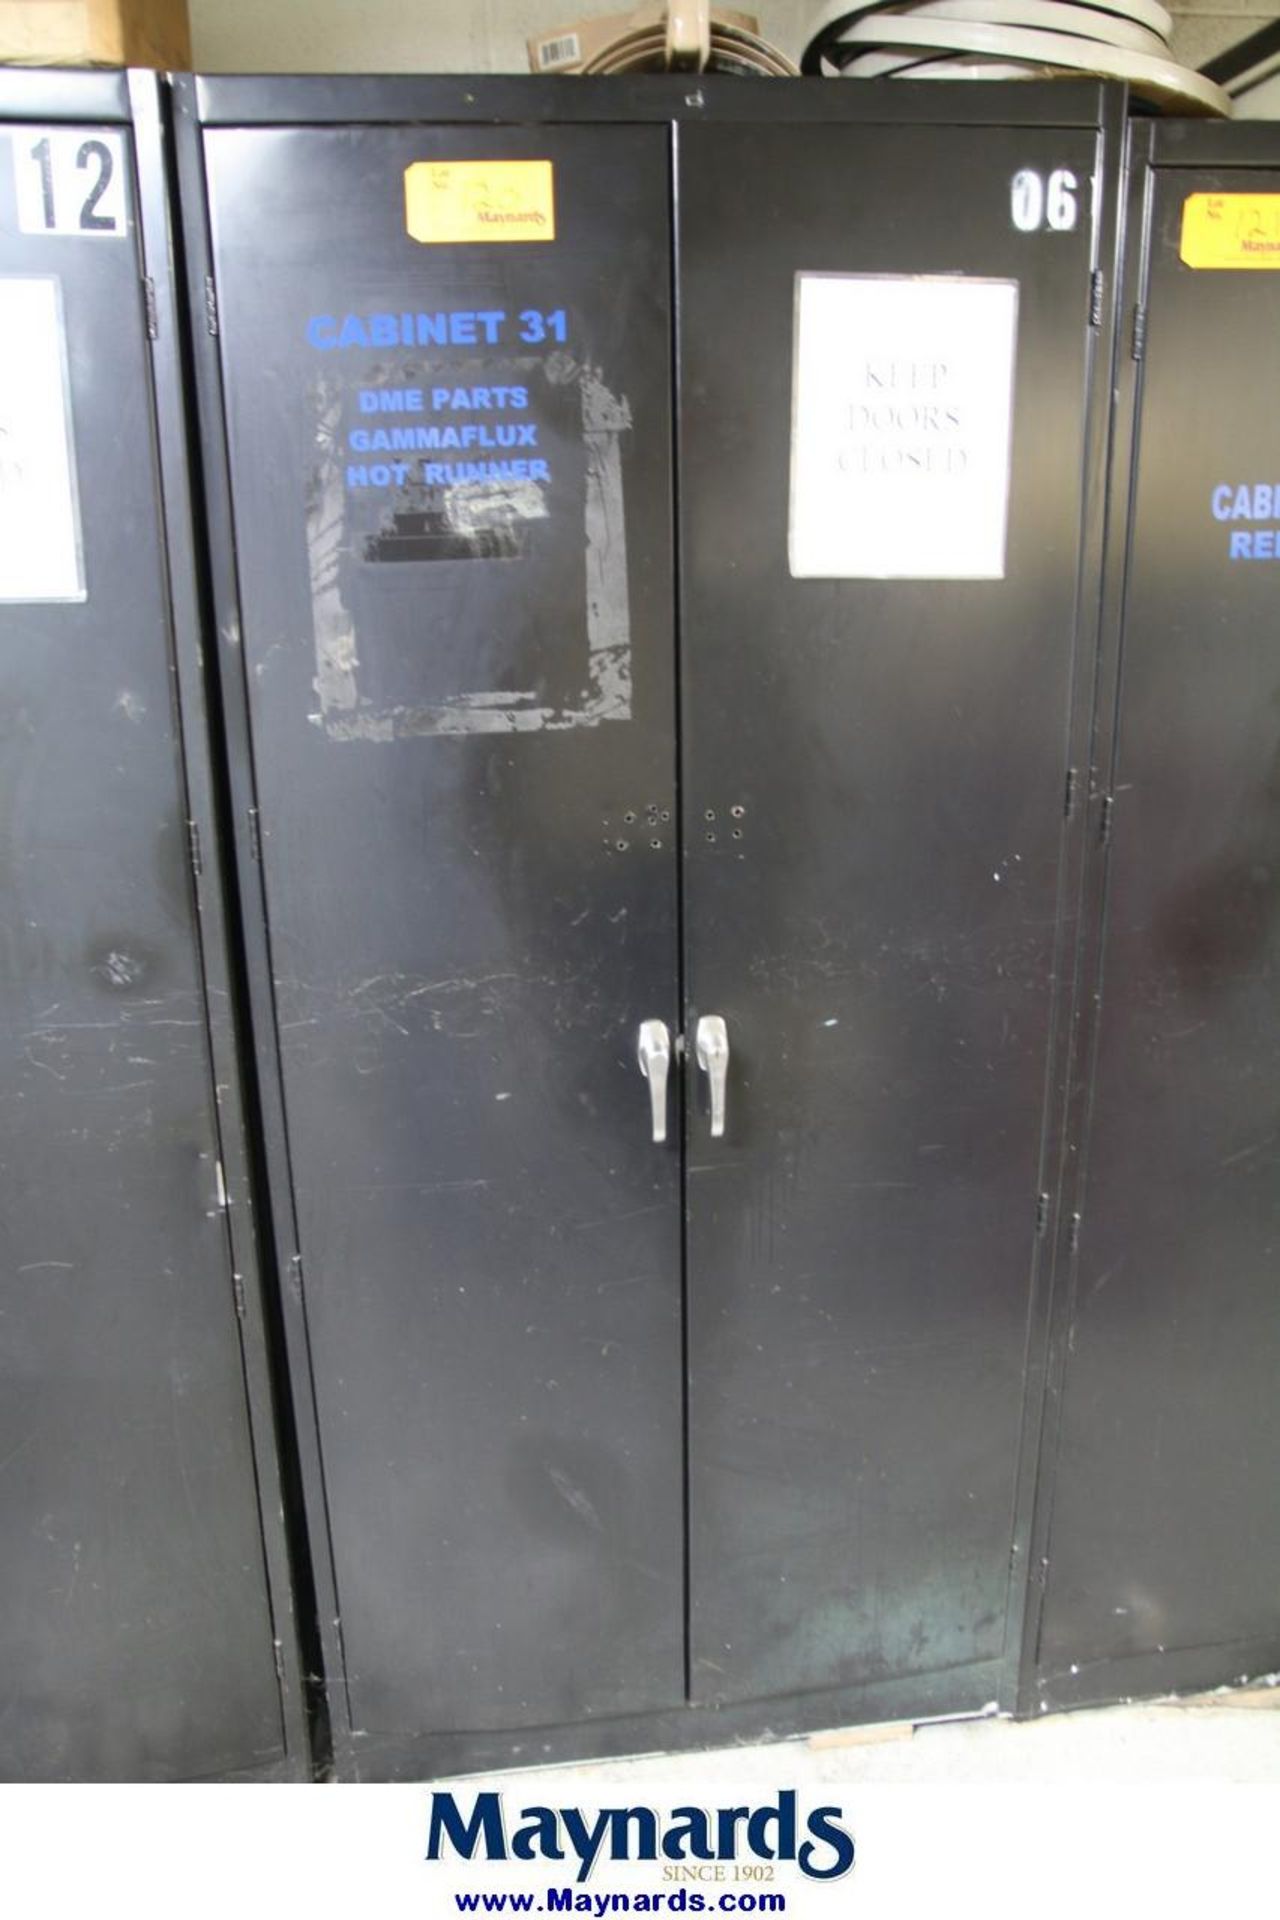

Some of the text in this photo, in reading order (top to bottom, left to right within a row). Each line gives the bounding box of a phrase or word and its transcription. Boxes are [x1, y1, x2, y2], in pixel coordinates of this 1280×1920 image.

[31, 138, 116, 230] 12
[1011, 169, 1077, 231] 06
[478, 211, 546, 226] Maynards
[307, 310, 567, 348] CABINET 31
[864, 361, 947, 389] KEEP
[358, 386, 528, 412] DME PARTS
[848, 402, 960, 431] DOORS
[349, 424, 538, 451] GAMMAFLUX
[347, 459, 550, 487] HOT RUNNER
[837, 445, 967, 473] CLOSED
